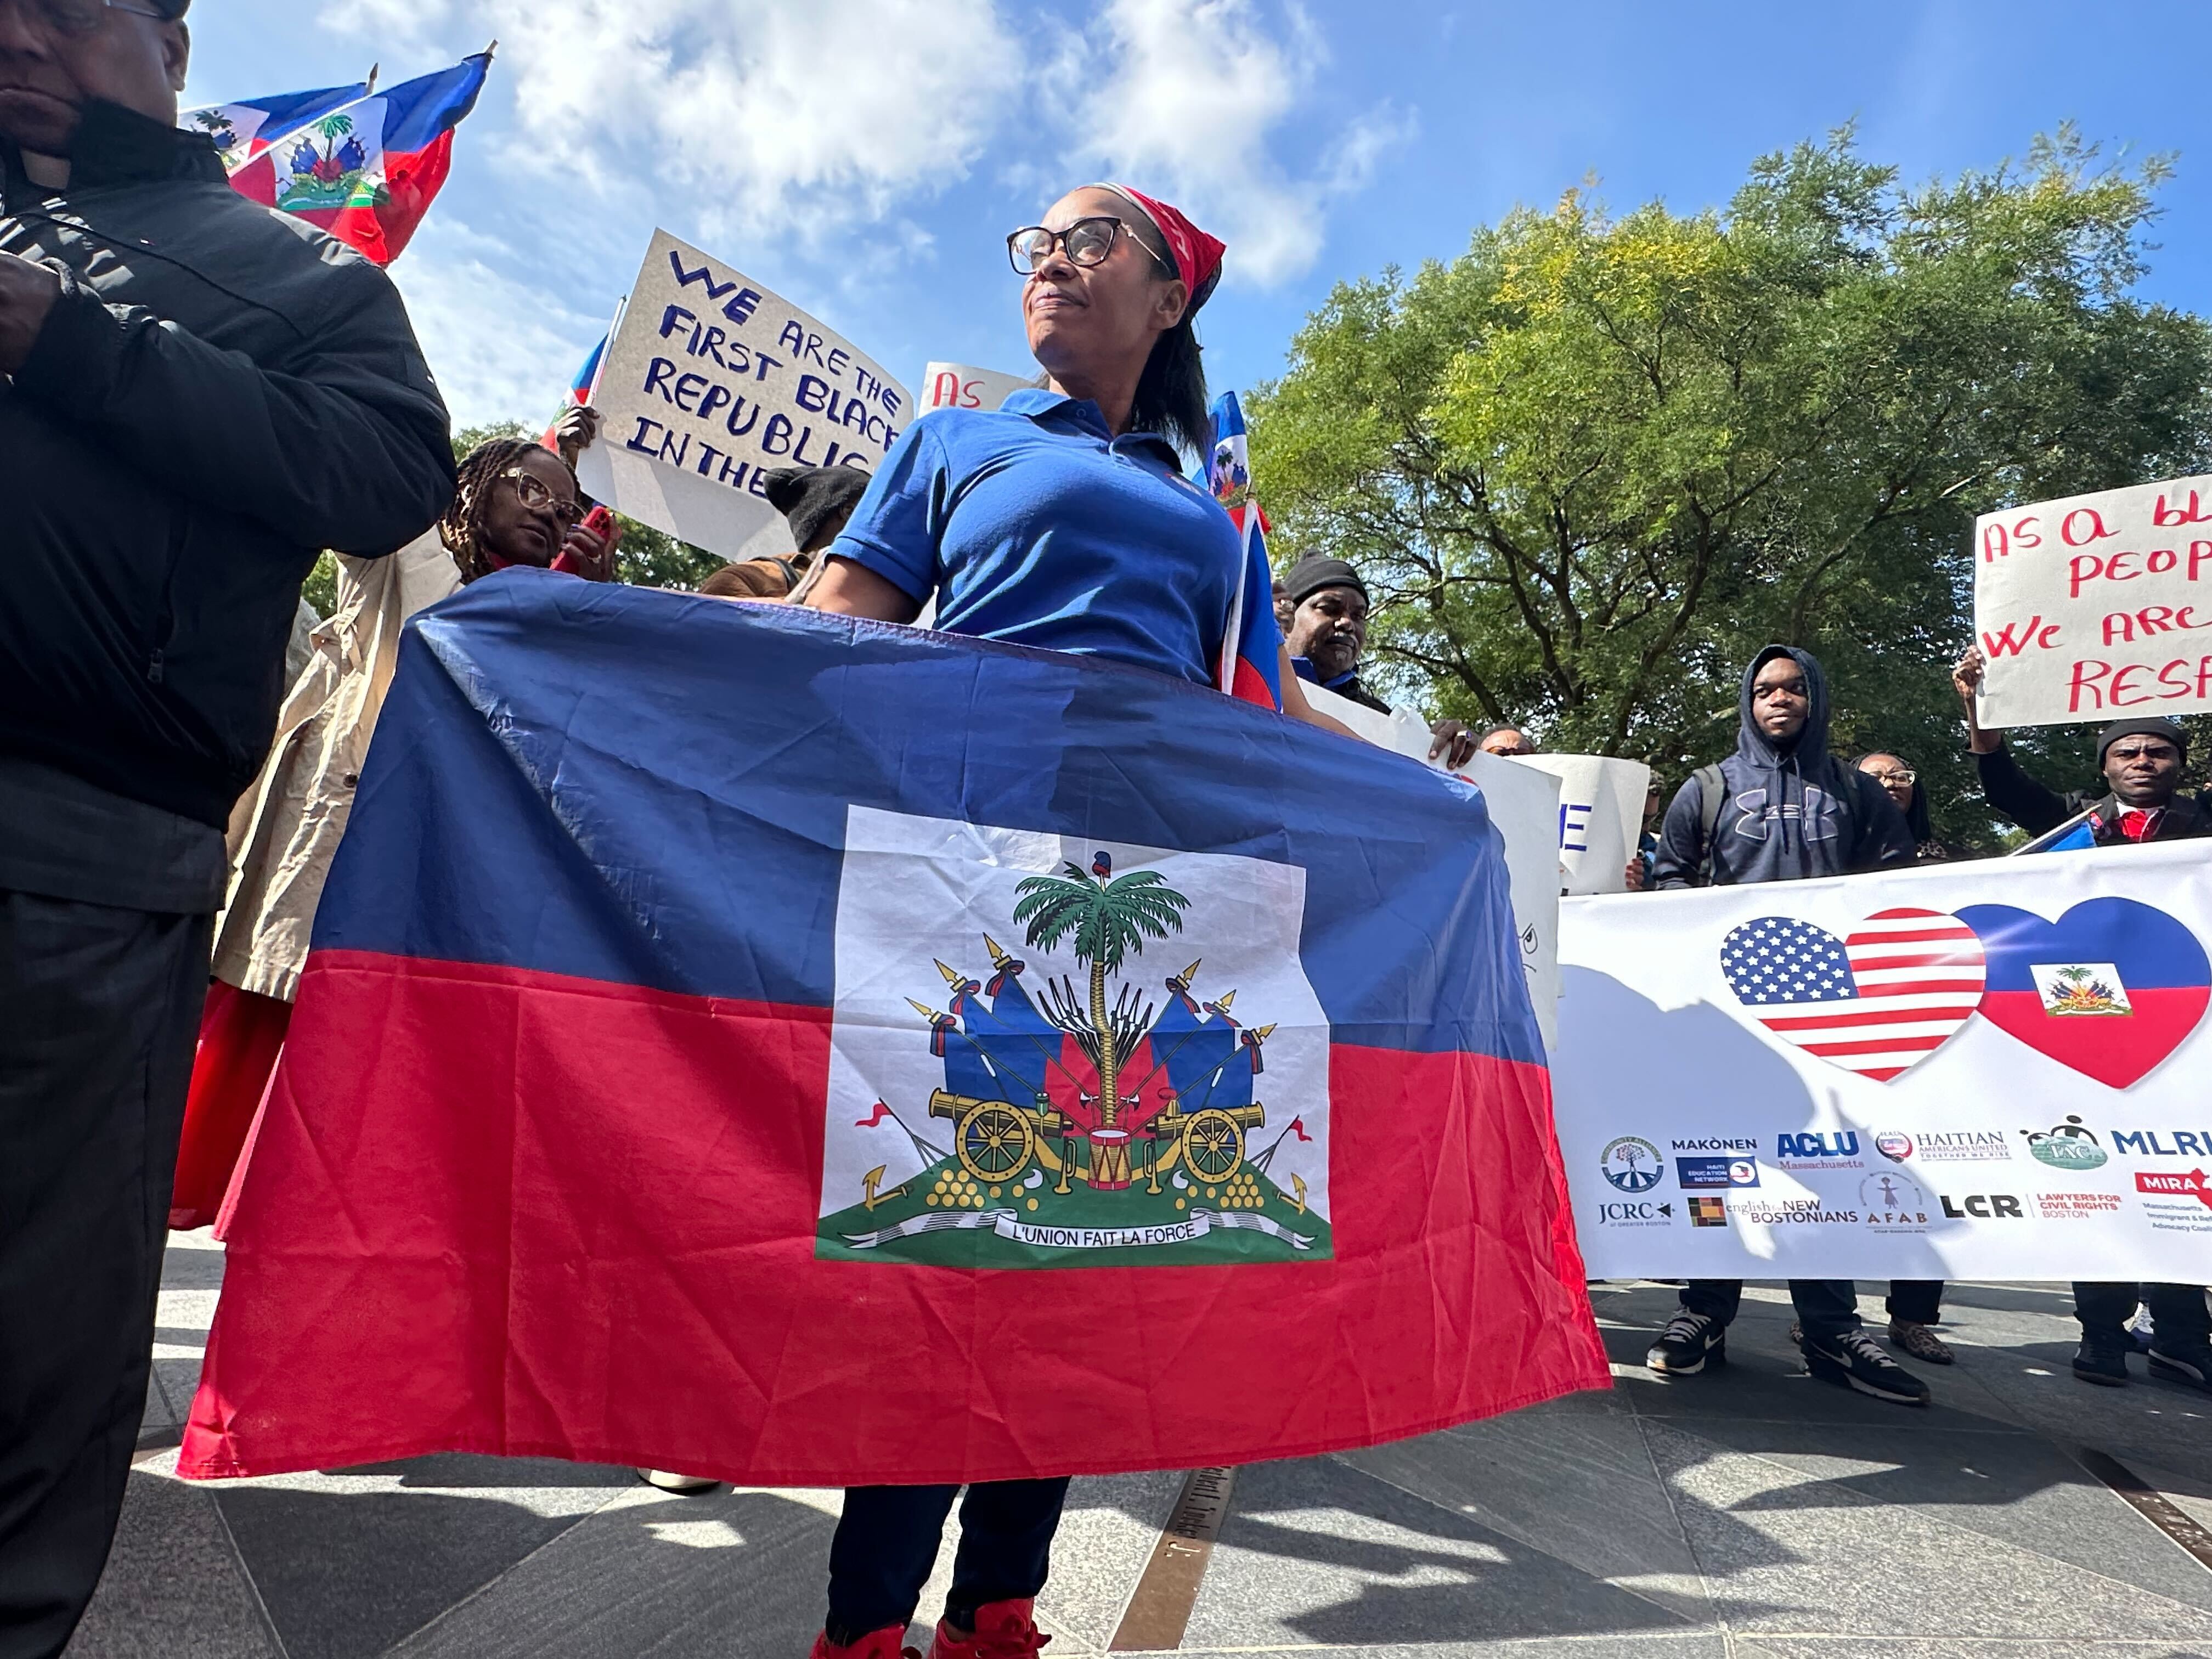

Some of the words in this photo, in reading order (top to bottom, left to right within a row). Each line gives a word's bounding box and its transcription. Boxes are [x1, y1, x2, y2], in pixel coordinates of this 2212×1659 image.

[669, 250, 763, 326] WE
[779, 320, 850, 375] ARE
[855, 366, 902, 417] THE
[658, 304, 783, 381] FIRST
[795, 374, 899, 453] BLACK
[933, 372, 985, 408] AS
[627, 416, 691, 467] IN
[698, 441, 768, 499] THE
[1983, 516, 2042, 562] AS
[1982, 615, 2065, 658] We
[1672, 1137, 1757, 1150] MAKÒNEN
[1778, 1131, 1859, 1158] ACLU
[1915, 1131, 2004, 1146] HAITIAN
[1779, 1160, 1865, 1170] Massachusetts
[2143, 1176, 2199, 1190] MIRA
[1726, 1200, 1771, 1216] english
[1783, 1199, 1821, 1211] NEW
[1939, 1194, 2024, 1218] LCR
[2036, 1193, 2096, 1201] LAWYERS
[2097, 1194, 2122, 1203] FOR
[2073, 1202, 2118, 1210] RIGHTS
[1599, 1202, 1655, 1224] JCRC
[1751, 1210, 1858, 1223] BOSTONIANS
[2042, 1210, 2089, 1218] BOSTON
[1013, 1224, 1078, 1246] L'UNION
[1084, 1231, 1118, 1246] FAIT
[1120, 1231, 1141, 1244] LA
[1145, 1222, 1197, 1243] FORCE
